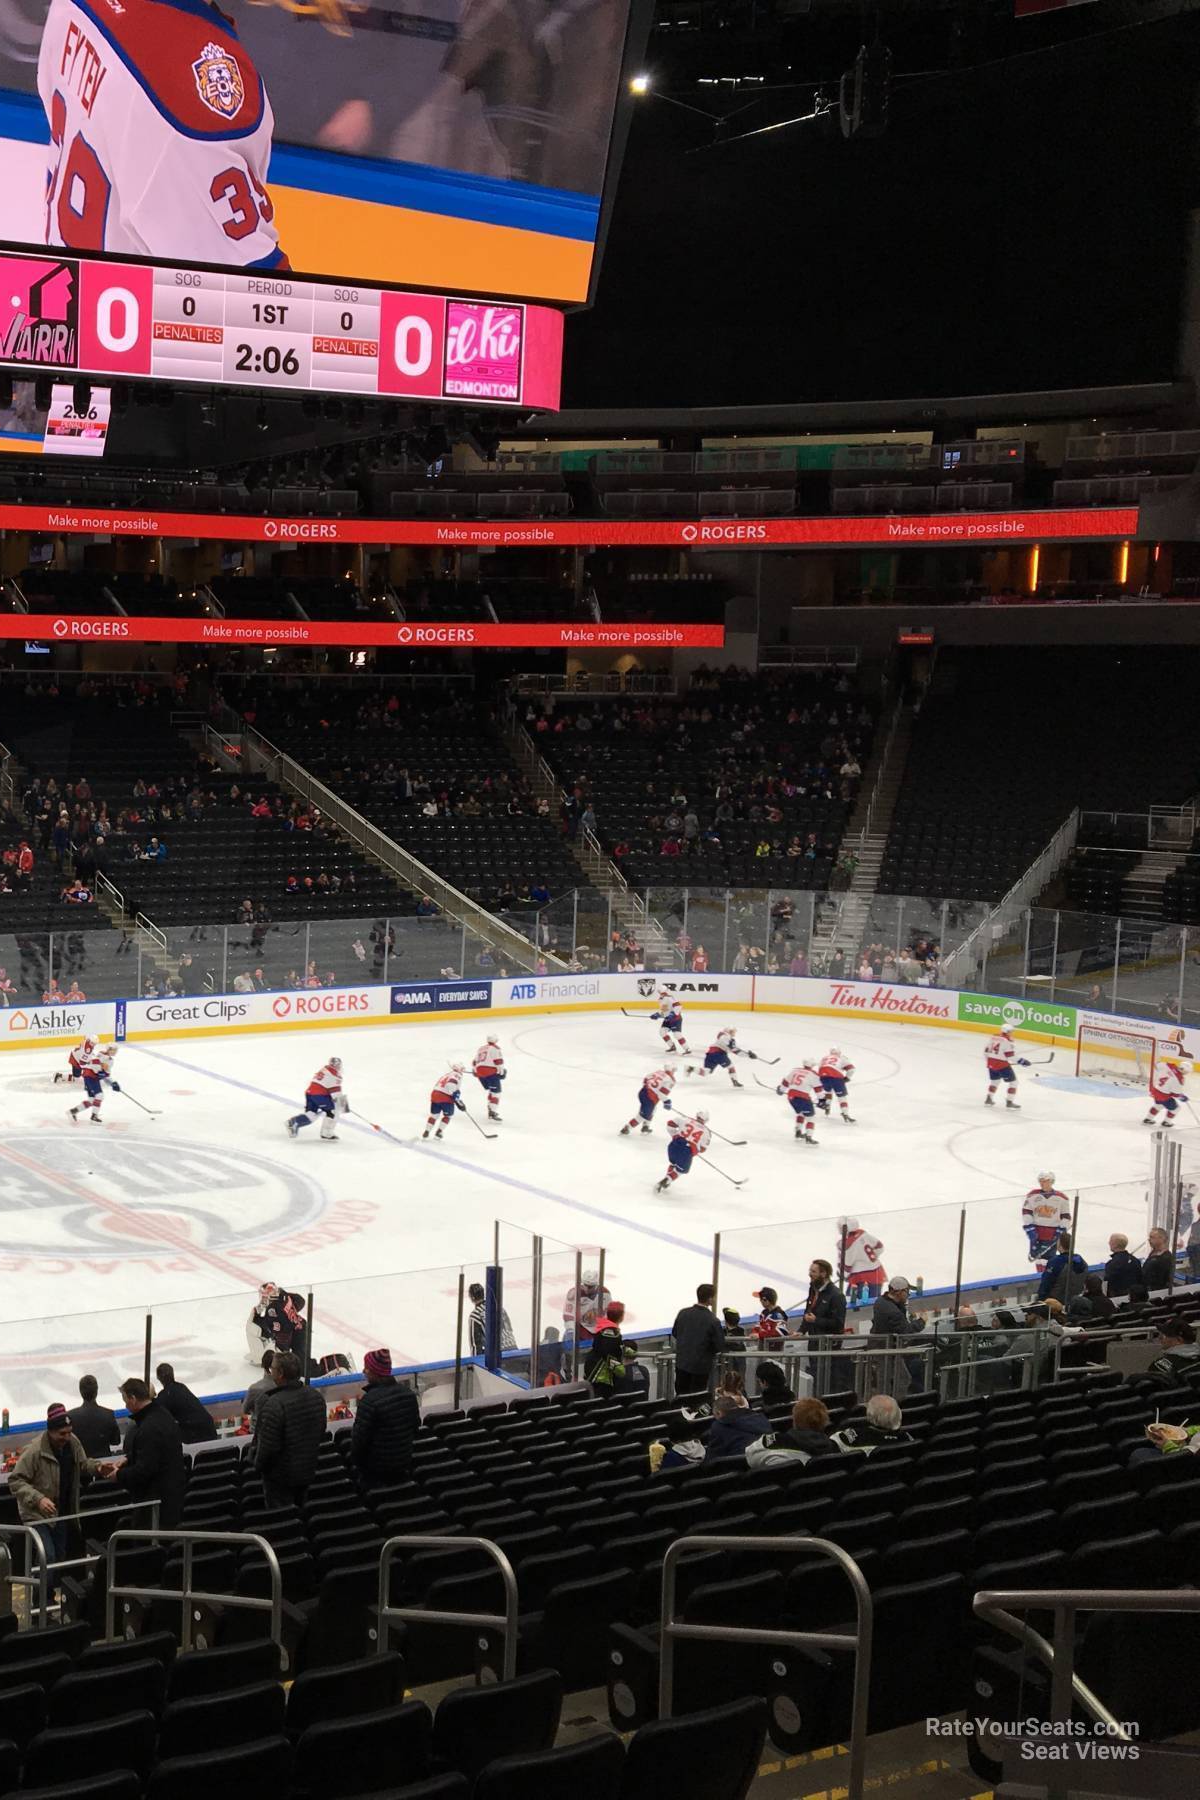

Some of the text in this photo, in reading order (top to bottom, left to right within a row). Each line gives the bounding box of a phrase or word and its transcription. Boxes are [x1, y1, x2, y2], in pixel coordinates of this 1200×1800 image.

[175, 272, 359, 303] SOG PERIOD SOG
[96, 286, 140, 353] 0
[182, 297, 196, 316] 0
[252, 303, 289, 325] 1ST
[340, 312, 353, 332] 0
[394, 315, 433, 377] 0
[155, 324, 377, 376] PENALTIES 2:06 PENALTIES
[446, 380, 517, 398] EDMONTON
[48, 514, 159, 531] Make more possible
[889, 520, 1025, 535] Make more possible
[280, 523, 337, 538] ROGERS
[437, 528, 554, 542] Make more possible
[701, 525, 766, 539] ROGERS
[71, 621, 129, 636] ROGERS
[203, 625, 309, 640] Make more possible
[416, 628, 474, 642] ROGERS
[561, 630, 683, 644] Make more possible
[510, 979, 600, 1000] ATB Financial
[666, 982, 719, 993] RAM
[295, 994, 369, 1014] ROGERS
[402, 992, 432, 1005] AMA
[439, 990, 488, 1003] EVERYDAY SAVES
[830, 984, 951, 1019] Tim Hortons
[146, 1000, 247, 1022] Great Clips
[964, 1001, 1071, 1029] save on foods
[29, 1010, 85, 1034] Ashley
[38, 1027, 76, 1036] HOMESTORE
